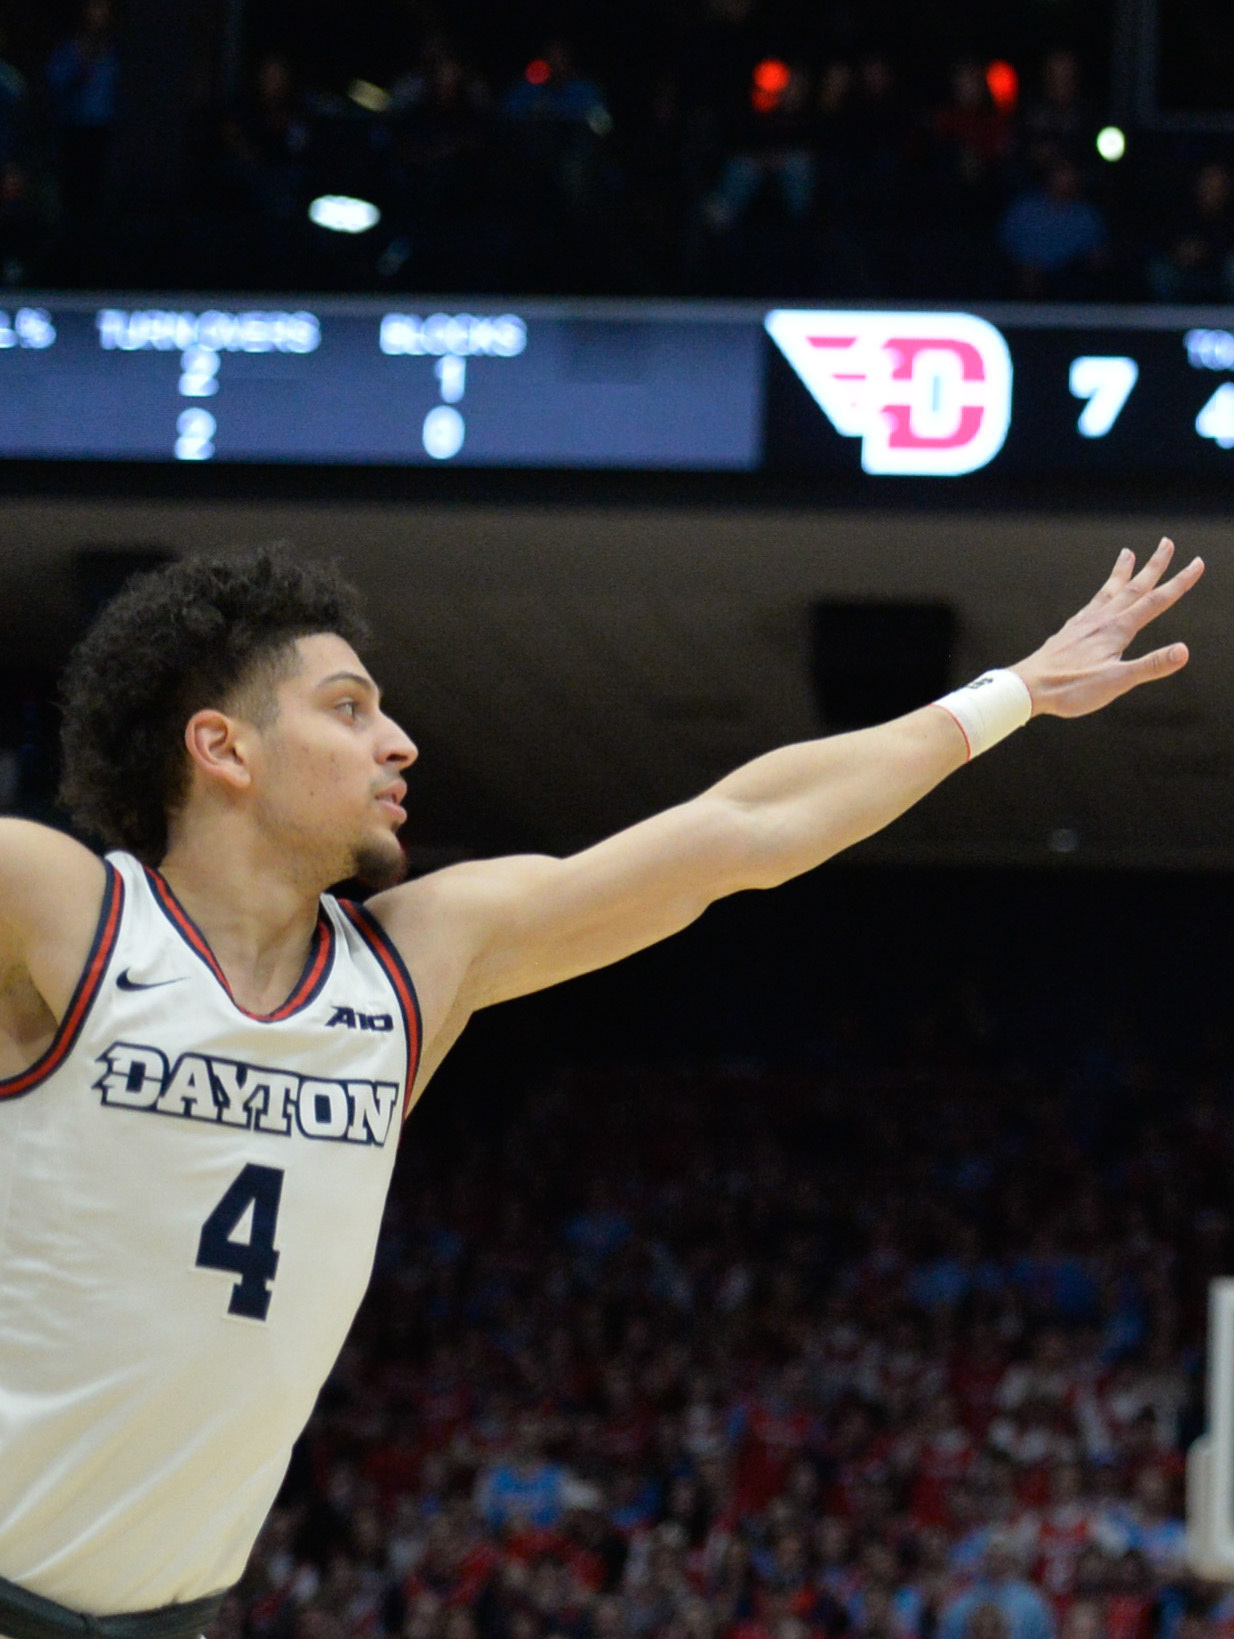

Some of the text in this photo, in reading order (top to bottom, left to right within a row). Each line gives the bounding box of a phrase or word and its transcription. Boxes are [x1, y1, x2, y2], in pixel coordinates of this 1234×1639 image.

[175, 405, 465, 461] 2 0
[1069, 356, 1139, 437] 7
[91, 1041, 399, 1147] DAYTON
[194, 1162, 285, 1322] 4
